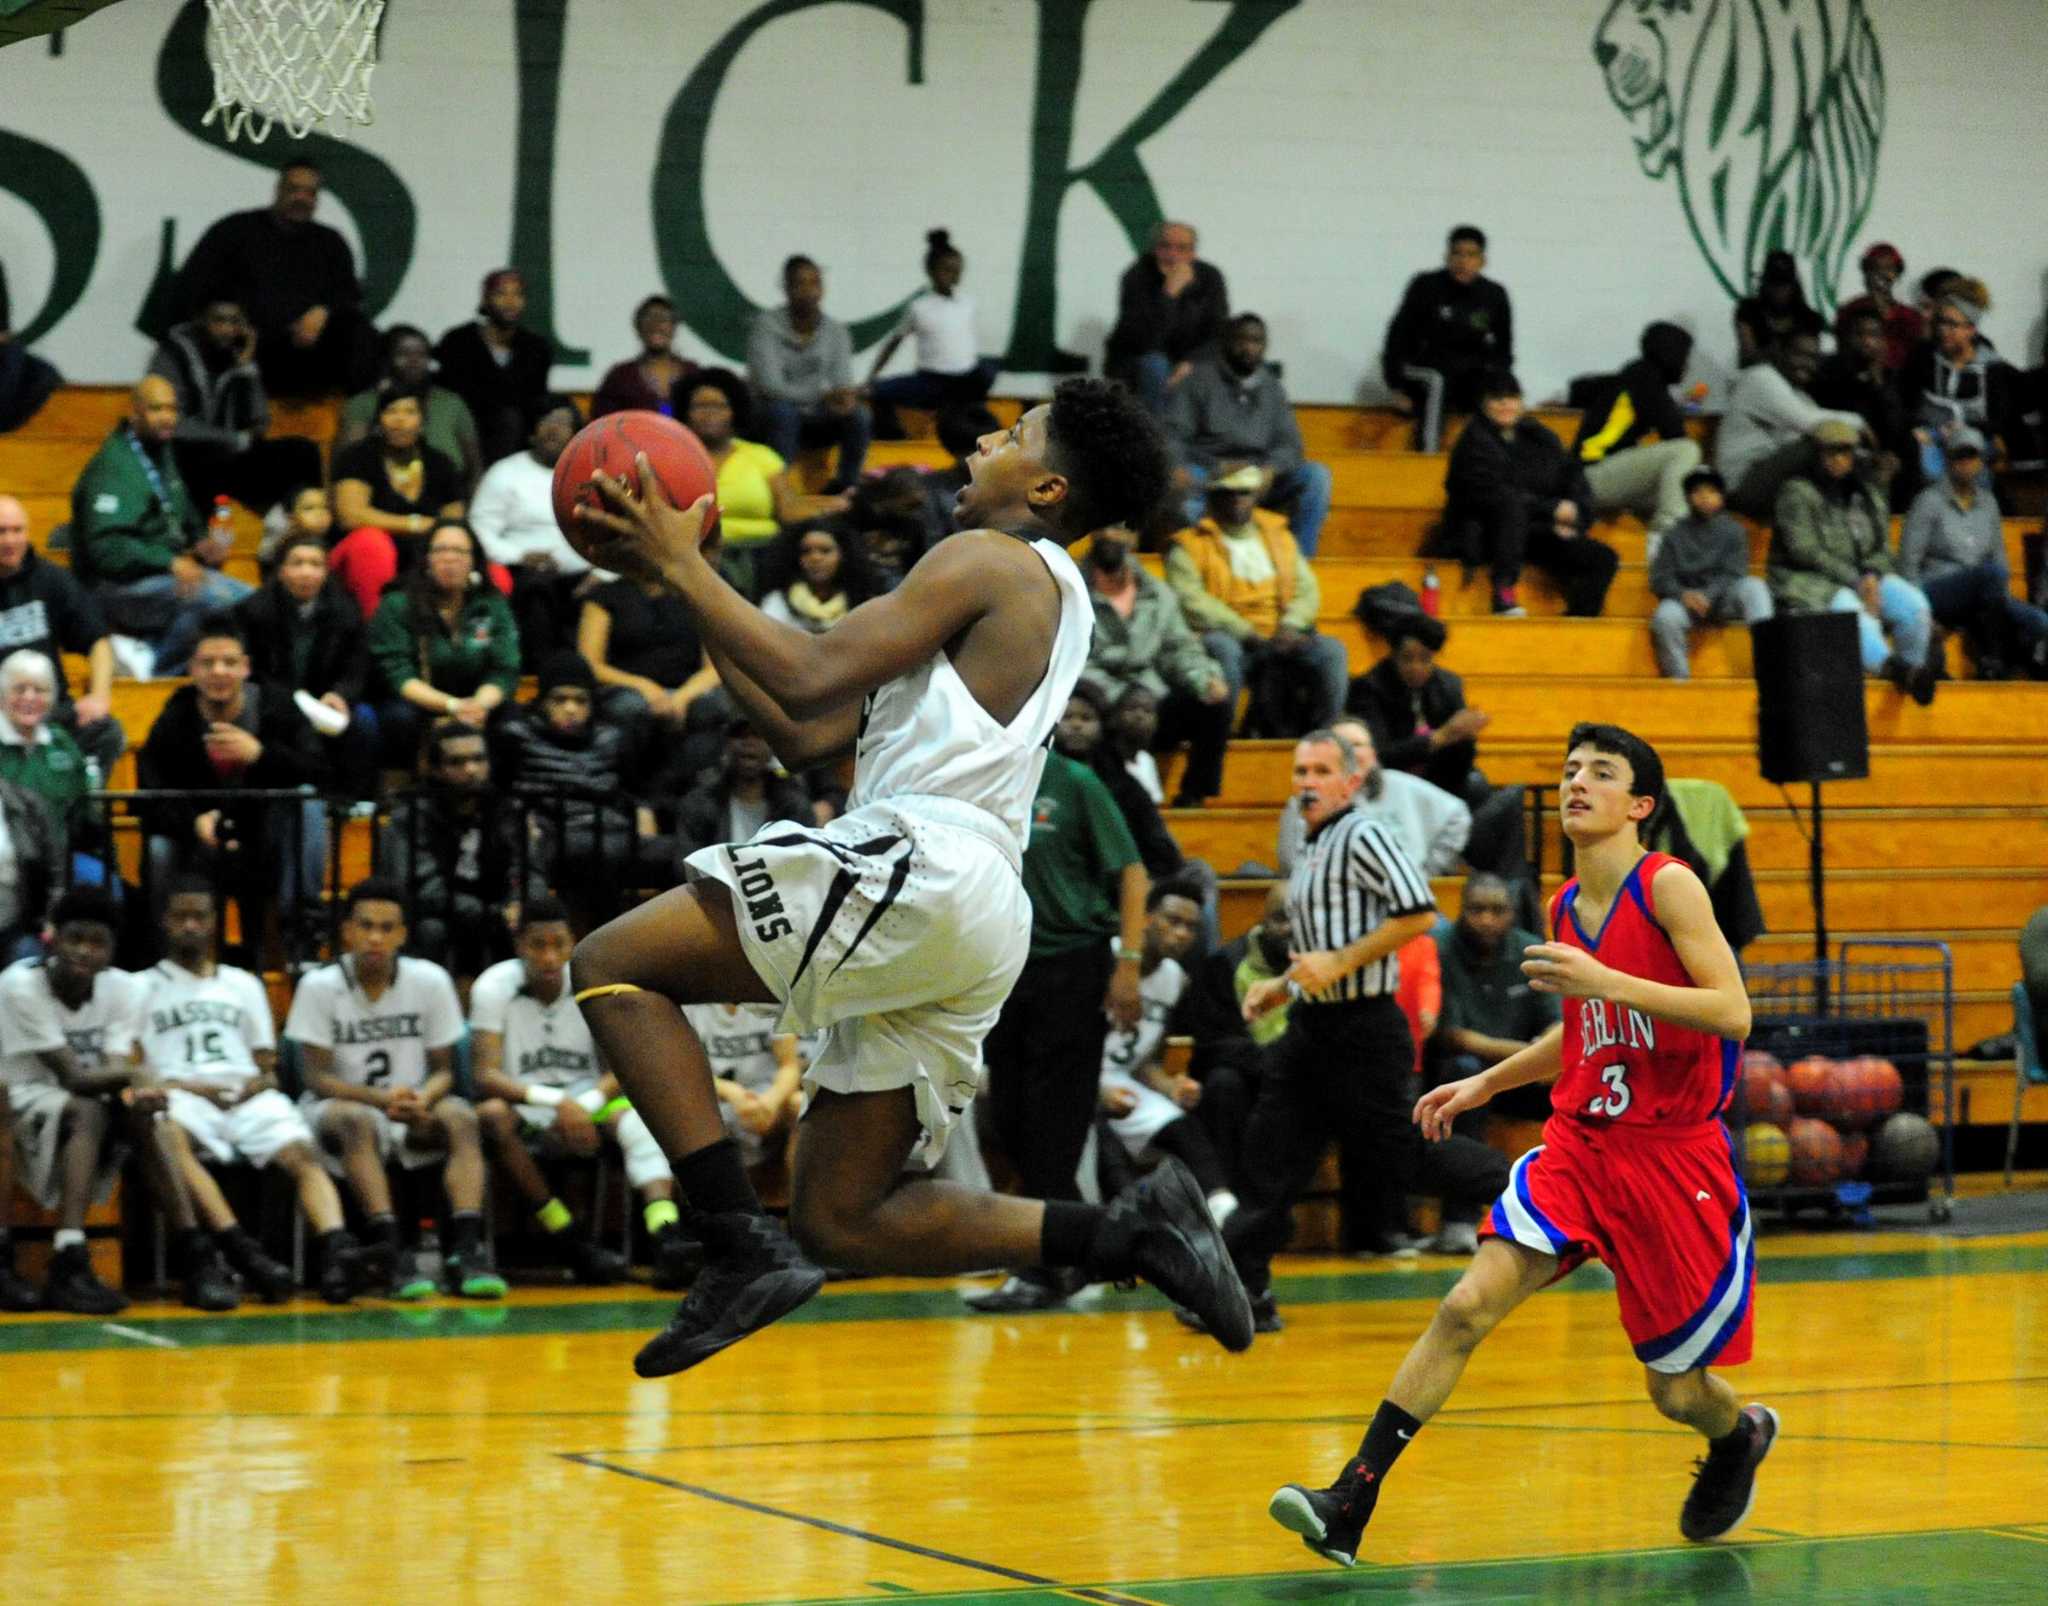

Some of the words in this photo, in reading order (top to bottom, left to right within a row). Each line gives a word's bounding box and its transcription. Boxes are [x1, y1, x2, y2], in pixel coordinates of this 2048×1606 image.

[726, 842, 793, 943] LIONS
[1579, 998, 1655, 1064] ERLIN
[365, 1050, 392, 1088] 2
[1588, 1064, 1631, 1117] 3
